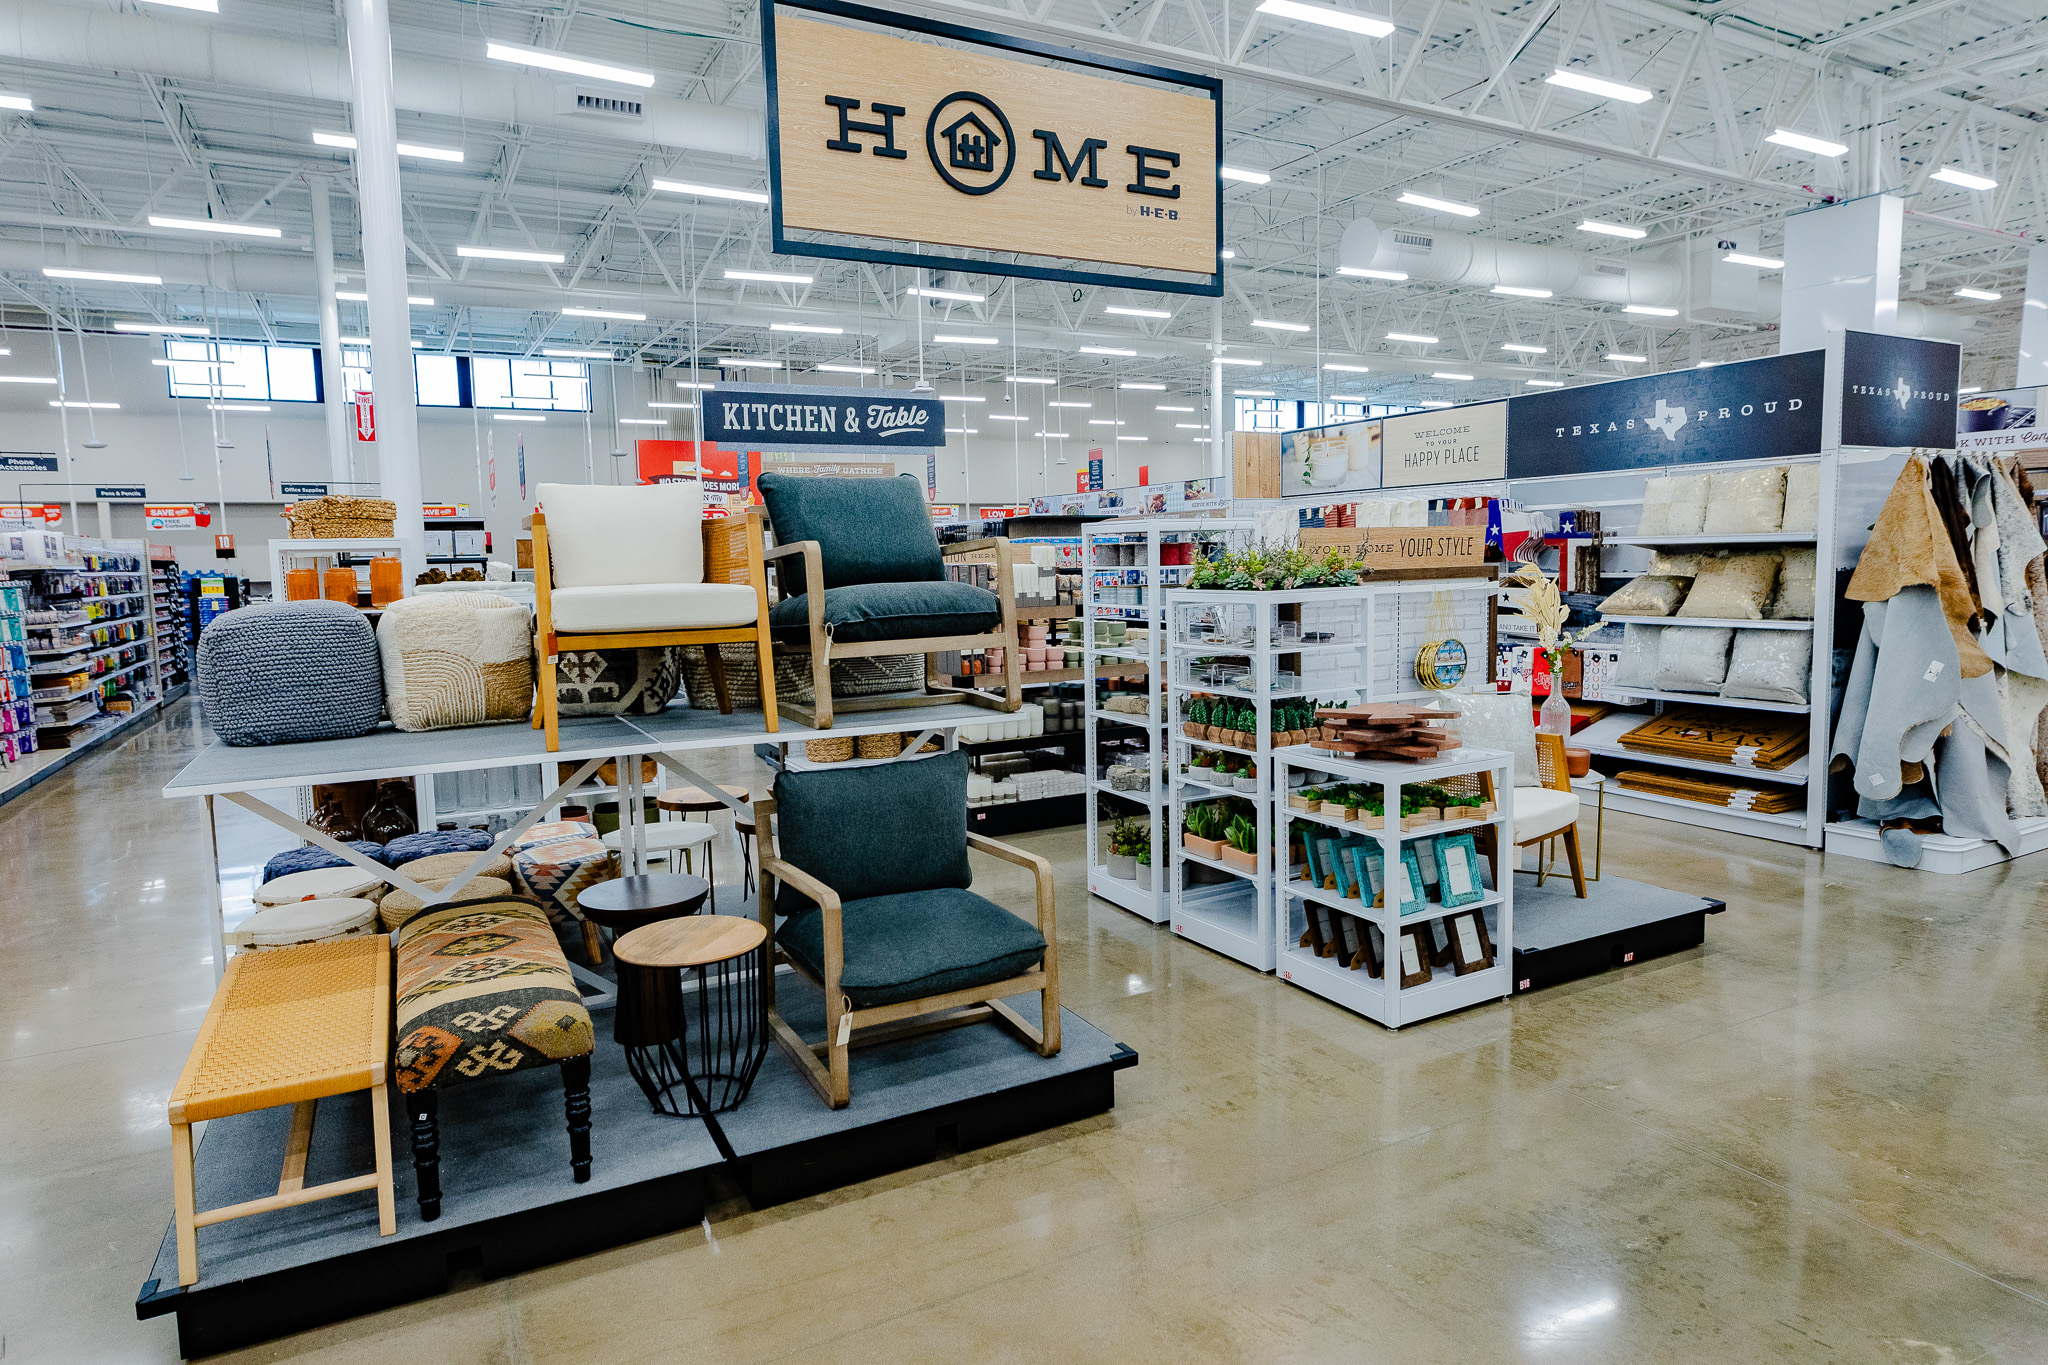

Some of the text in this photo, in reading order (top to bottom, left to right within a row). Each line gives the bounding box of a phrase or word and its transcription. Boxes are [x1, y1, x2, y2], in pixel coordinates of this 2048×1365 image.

[825, 91, 1181, 199] HOME
[1127, 205, 1138, 217] by
[1852, 385, 1950, 402] TEXAS PROUD
[722, 402, 930, 438] KITCHEN & Table
[1556, 398, 1804, 438] TEXAS PROUD
[1414, 425, 1471, 439] WELCOME
[1974, 435, 2016, 447] WITH
[1404, 445, 1480, 468] HAPPY PLACE
[813, 464, 840, 476] Family
[703, 481, 718, 491] OES
[219, 536, 230, 548] 10
[1313, 544, 1351, 554] YOUR
[1400, 537, 1433, 557] YOUR
[1437, 536, 1474, 556] STYLE
[1512, 624, 1527, 632] TAKE
